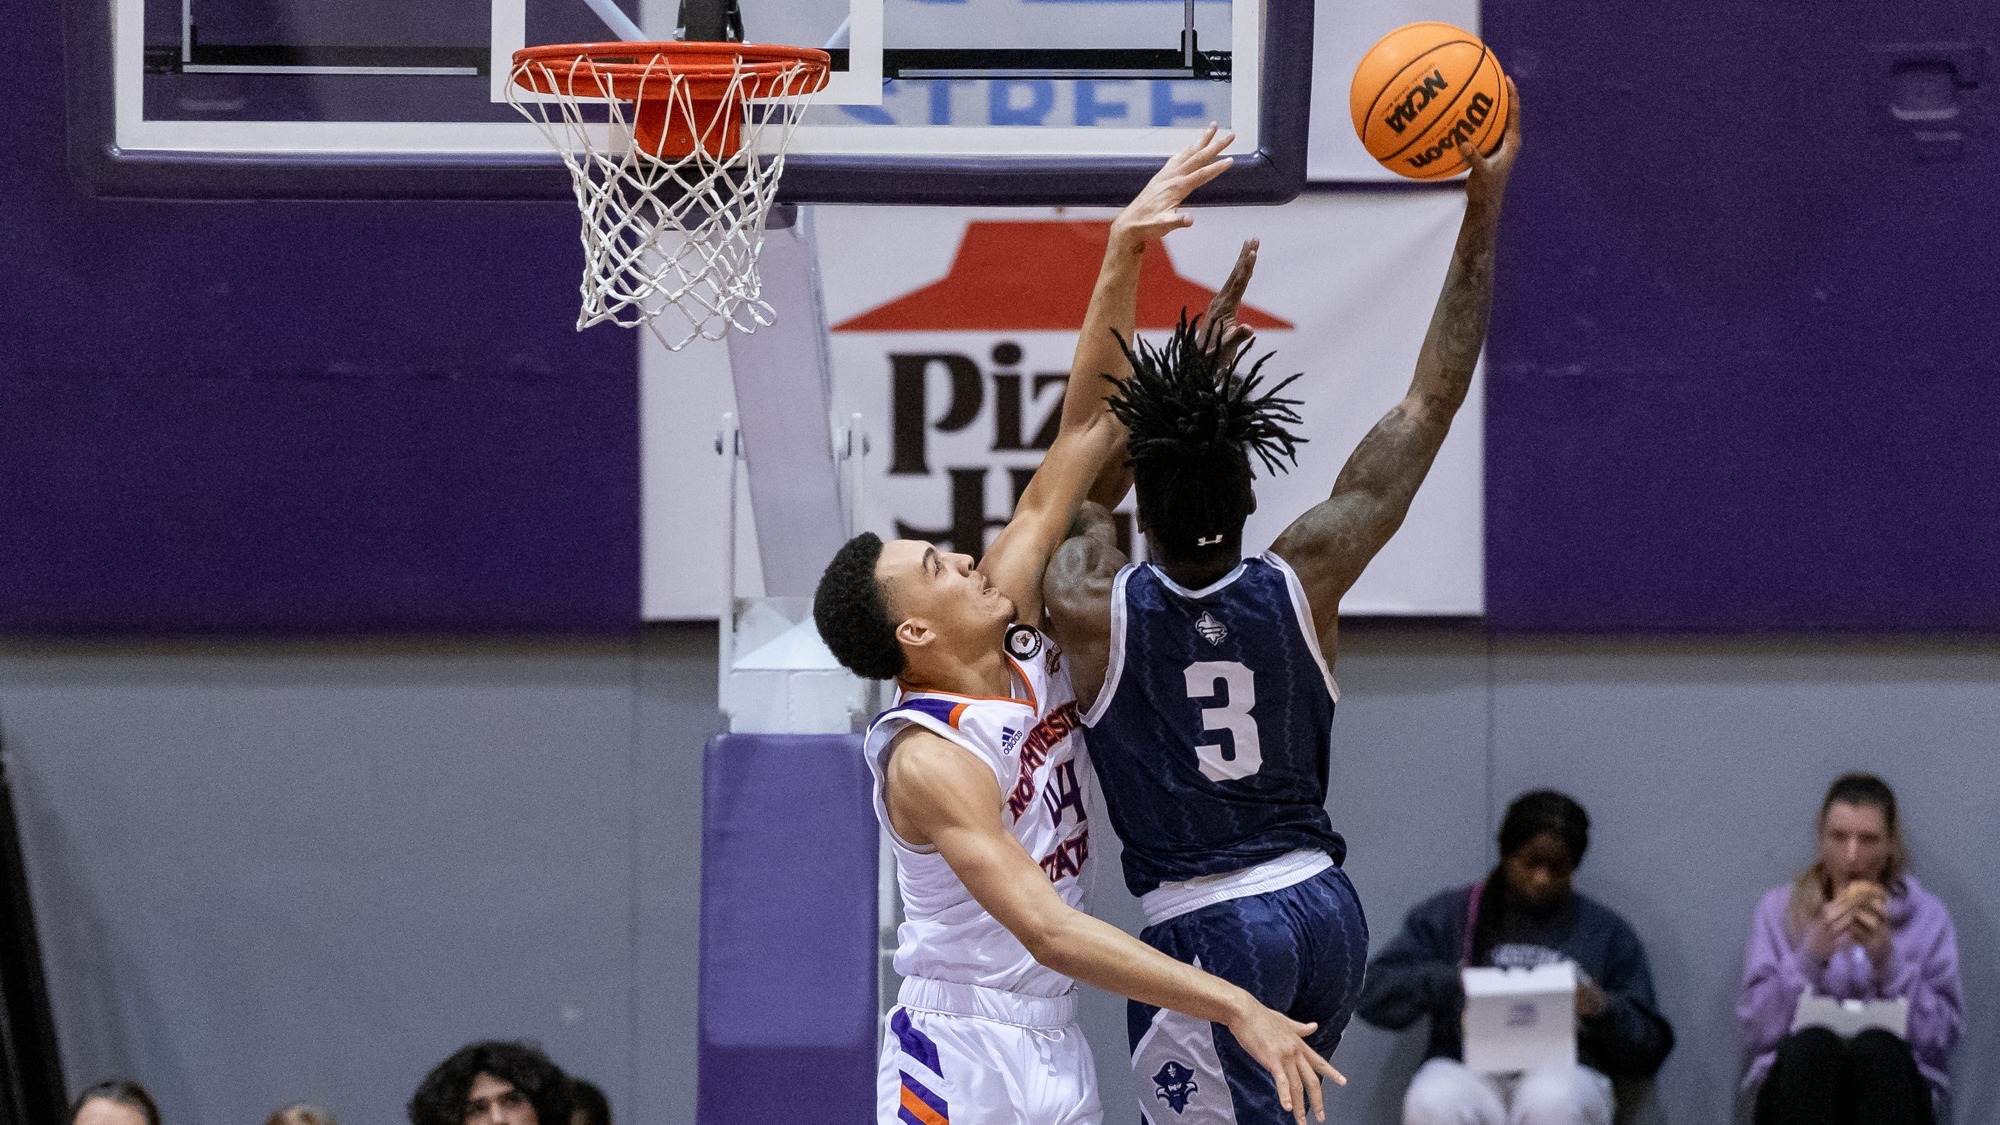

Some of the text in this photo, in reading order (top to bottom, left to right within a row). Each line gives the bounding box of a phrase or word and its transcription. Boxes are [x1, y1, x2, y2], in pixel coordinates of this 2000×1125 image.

[1384, 69, 1448, 135] NCAA
[1409, 92, 1494, 168] Wilson
[1003, 730, 1023, 756] adidas
[1182, 660, 1263, 782] 3
